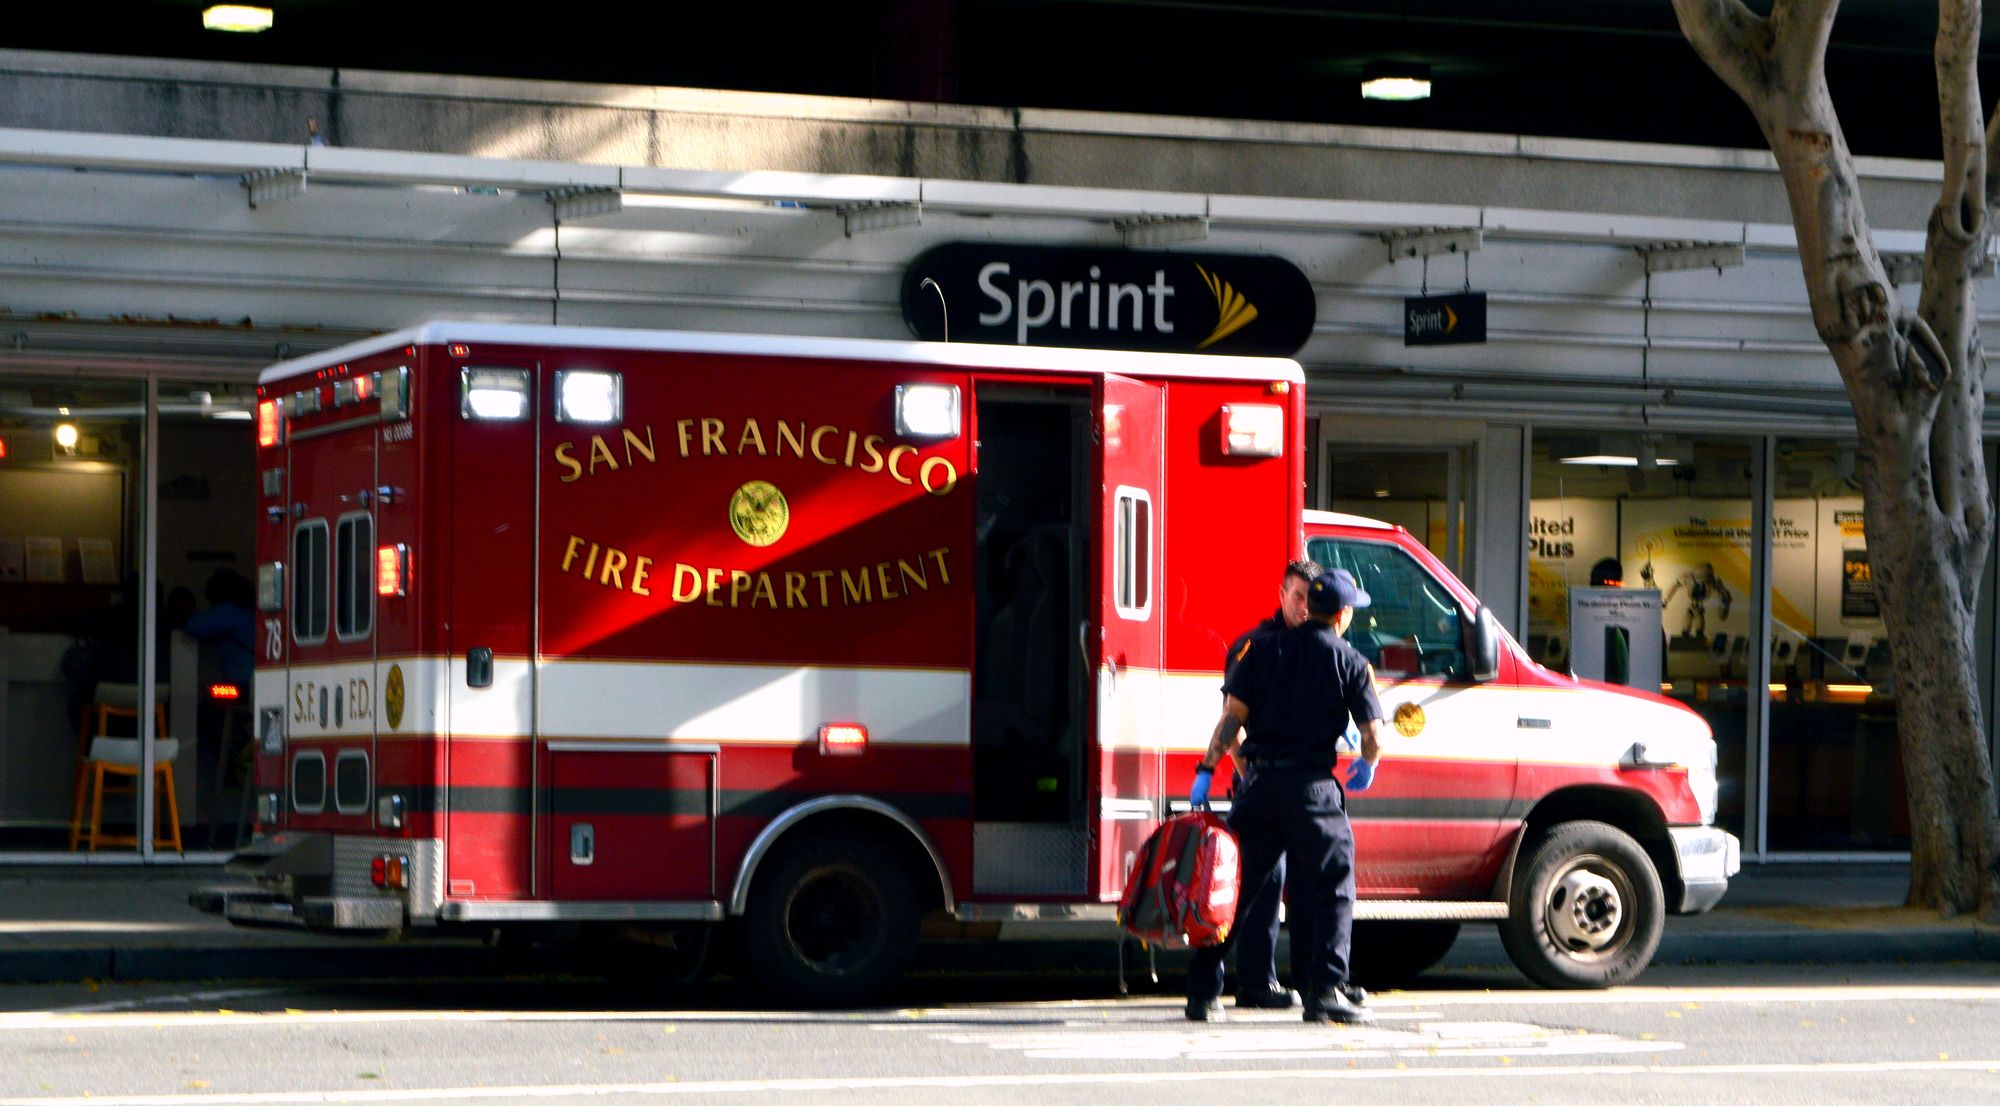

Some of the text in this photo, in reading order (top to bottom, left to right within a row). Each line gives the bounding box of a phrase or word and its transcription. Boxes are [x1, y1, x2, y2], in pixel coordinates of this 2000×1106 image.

[978, 262, 1175, 344] Sprint
[1409, 307, 1442, 337] Sprint
[554, 417, 957, 496] SAN FRANCISCO
[561, 535, 950, 609] FIRE DEPARTMENT
[265, 618, 282, 660] 78
[294, 676, 372, 723] S.F. F.D.
